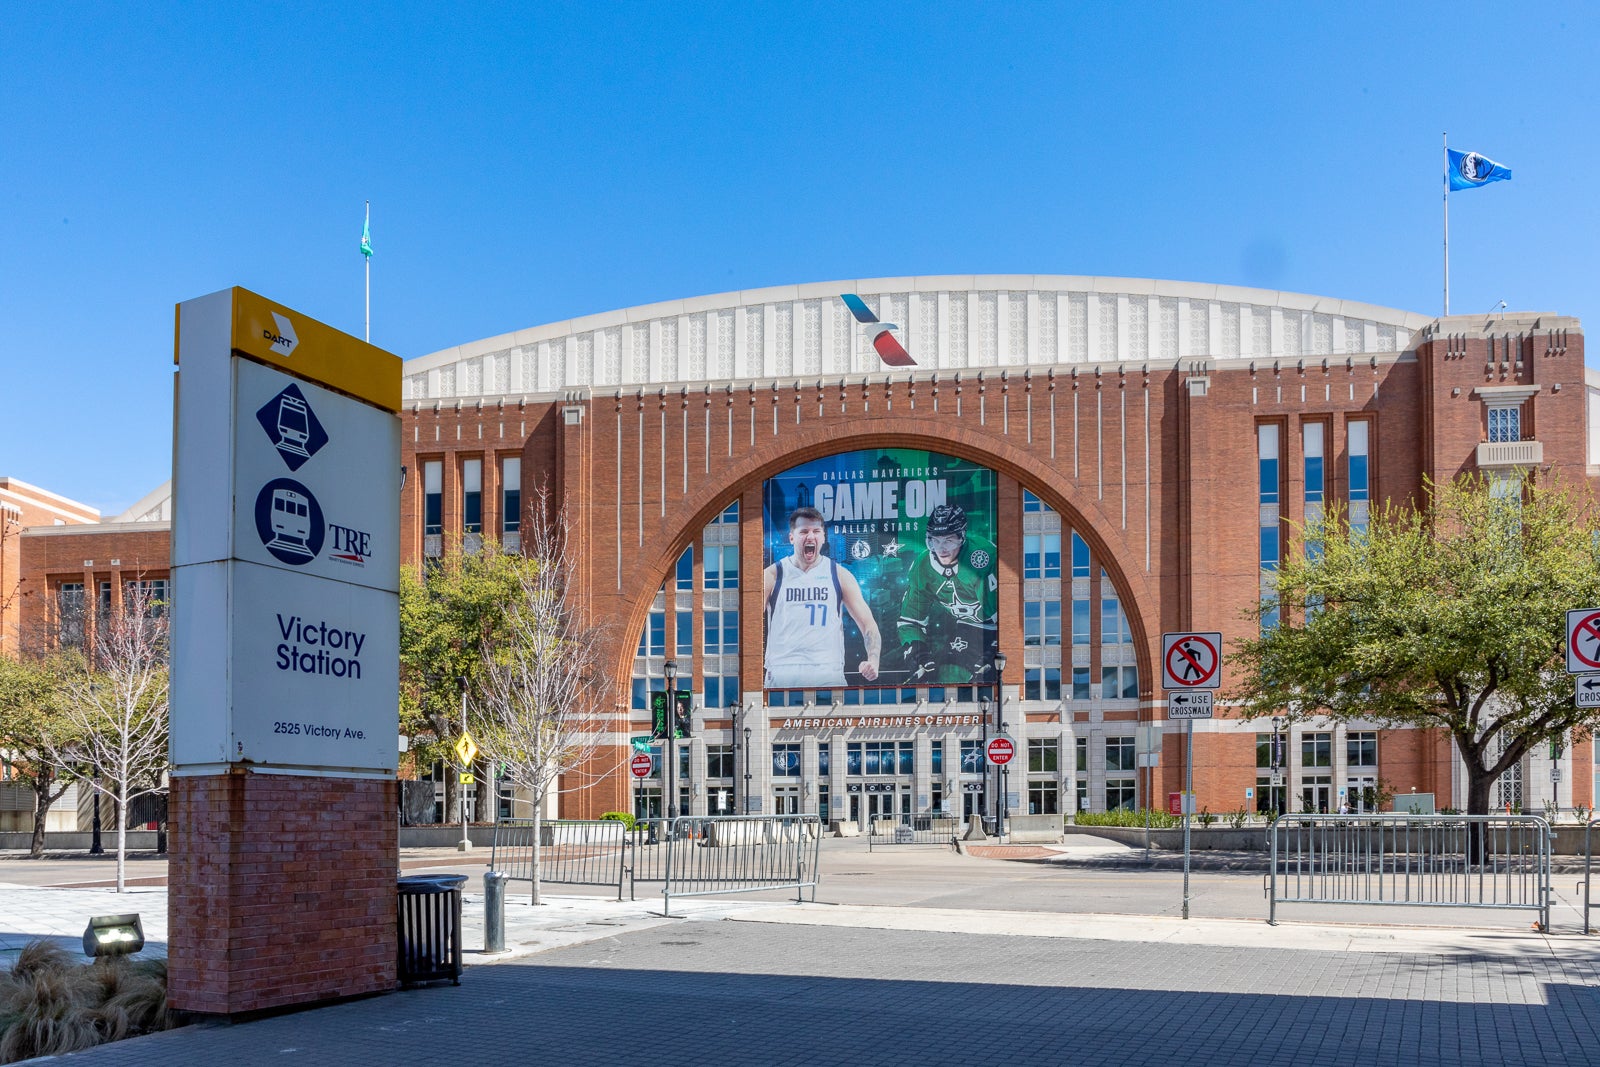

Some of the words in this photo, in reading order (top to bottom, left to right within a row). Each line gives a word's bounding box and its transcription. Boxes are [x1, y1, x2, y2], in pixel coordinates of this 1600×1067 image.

[263, 329, 292, 348] DART
[823, 470, 864, 481] DALLAS
[872, 467, 938, 479] MAVERICKS
[814, 481, 899, 522] GAME
[905, 479, 947, 518] ON
[834, 523, 876, 534] DALLAS
[883, 521, 919, 532] STARS
[328, 523, 372, 557] TRE
[786, 587, 829, 602] DALLAS
[804, 603, 828, 626] 77
[276, 613, 366, 657] Victory
[276, 643, 361, 679] Station
[1191, 695, 1209, 704] USE
[1579, 692, 1600, 702] CROS
[1170, 706, 1211, 716] CROSSWALK
[783, 718, 853, 728] AMERICAN
[857, 716, 921, 727] AIRLINES
[925, 715, 981, 726] CENTER
[273, 721, 301, 735] 2525
[303, 724, 341, 740] Victory
[343, 727, 366, 740] Ave.
